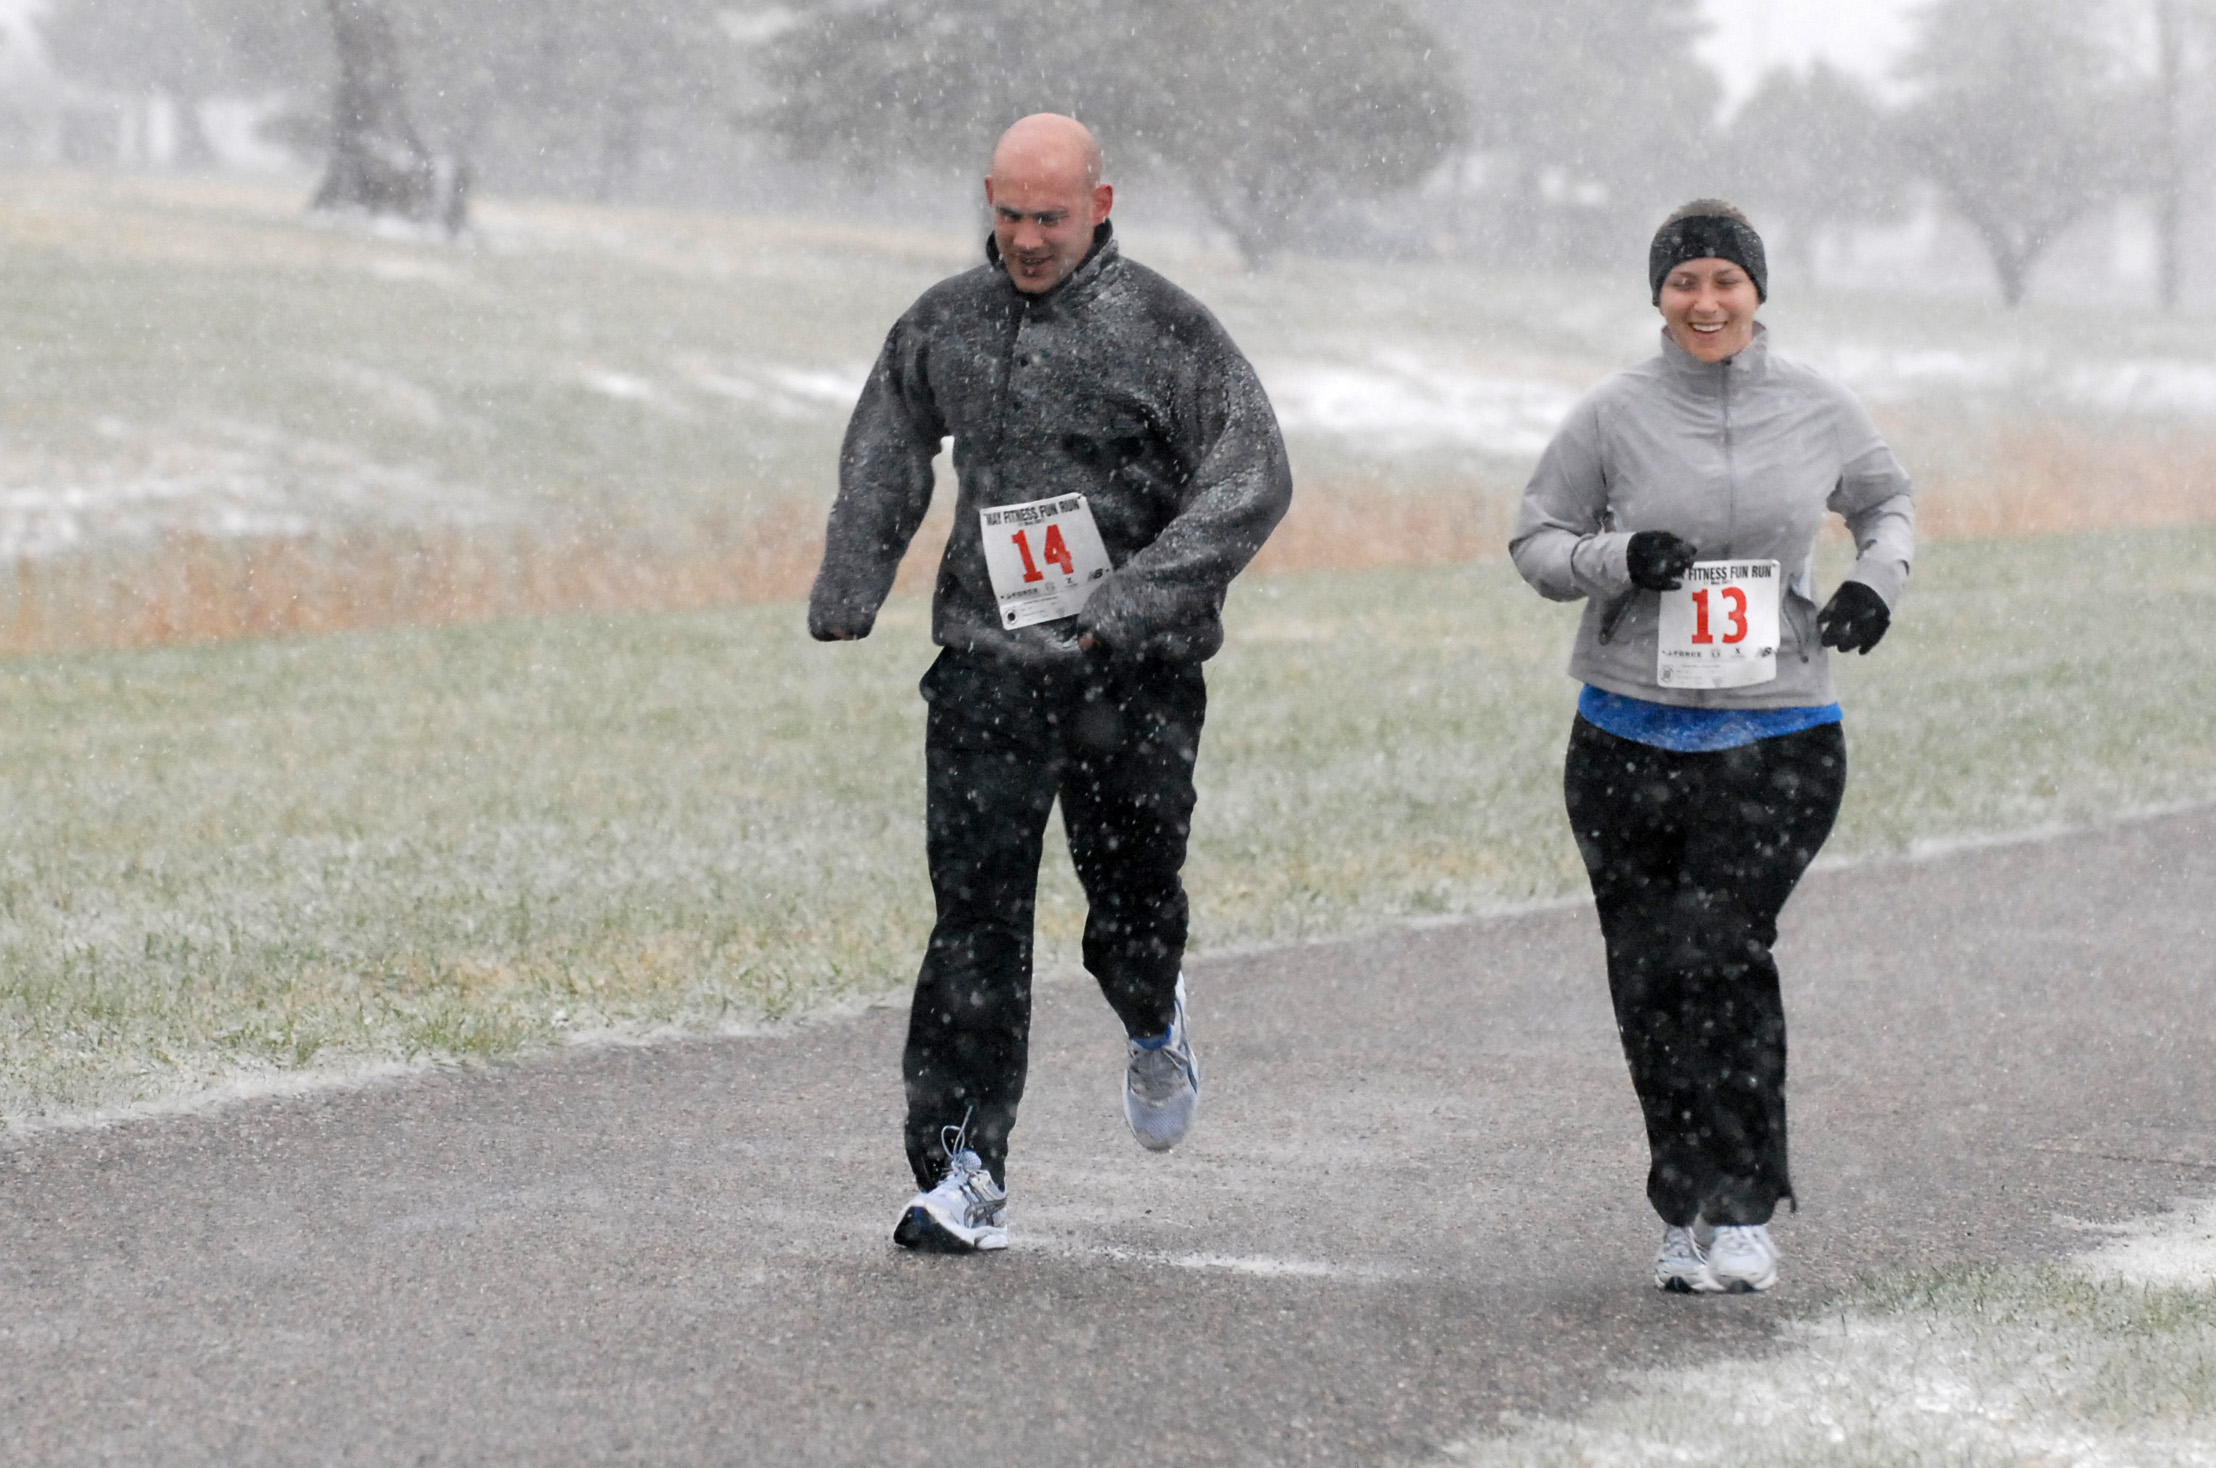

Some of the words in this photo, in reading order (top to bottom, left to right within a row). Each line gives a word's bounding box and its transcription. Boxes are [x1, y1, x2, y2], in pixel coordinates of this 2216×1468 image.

[1003, 506, 1039, 524] FITNESS
[1039, 503, 1059, 518] FUN
[1011, 524, 1074, 583] 14
[1688, 567, 1727, 581] FITNESS
[1730, 565, 1749, 579] FUN
[1691, 587, 1748, 644] 13
